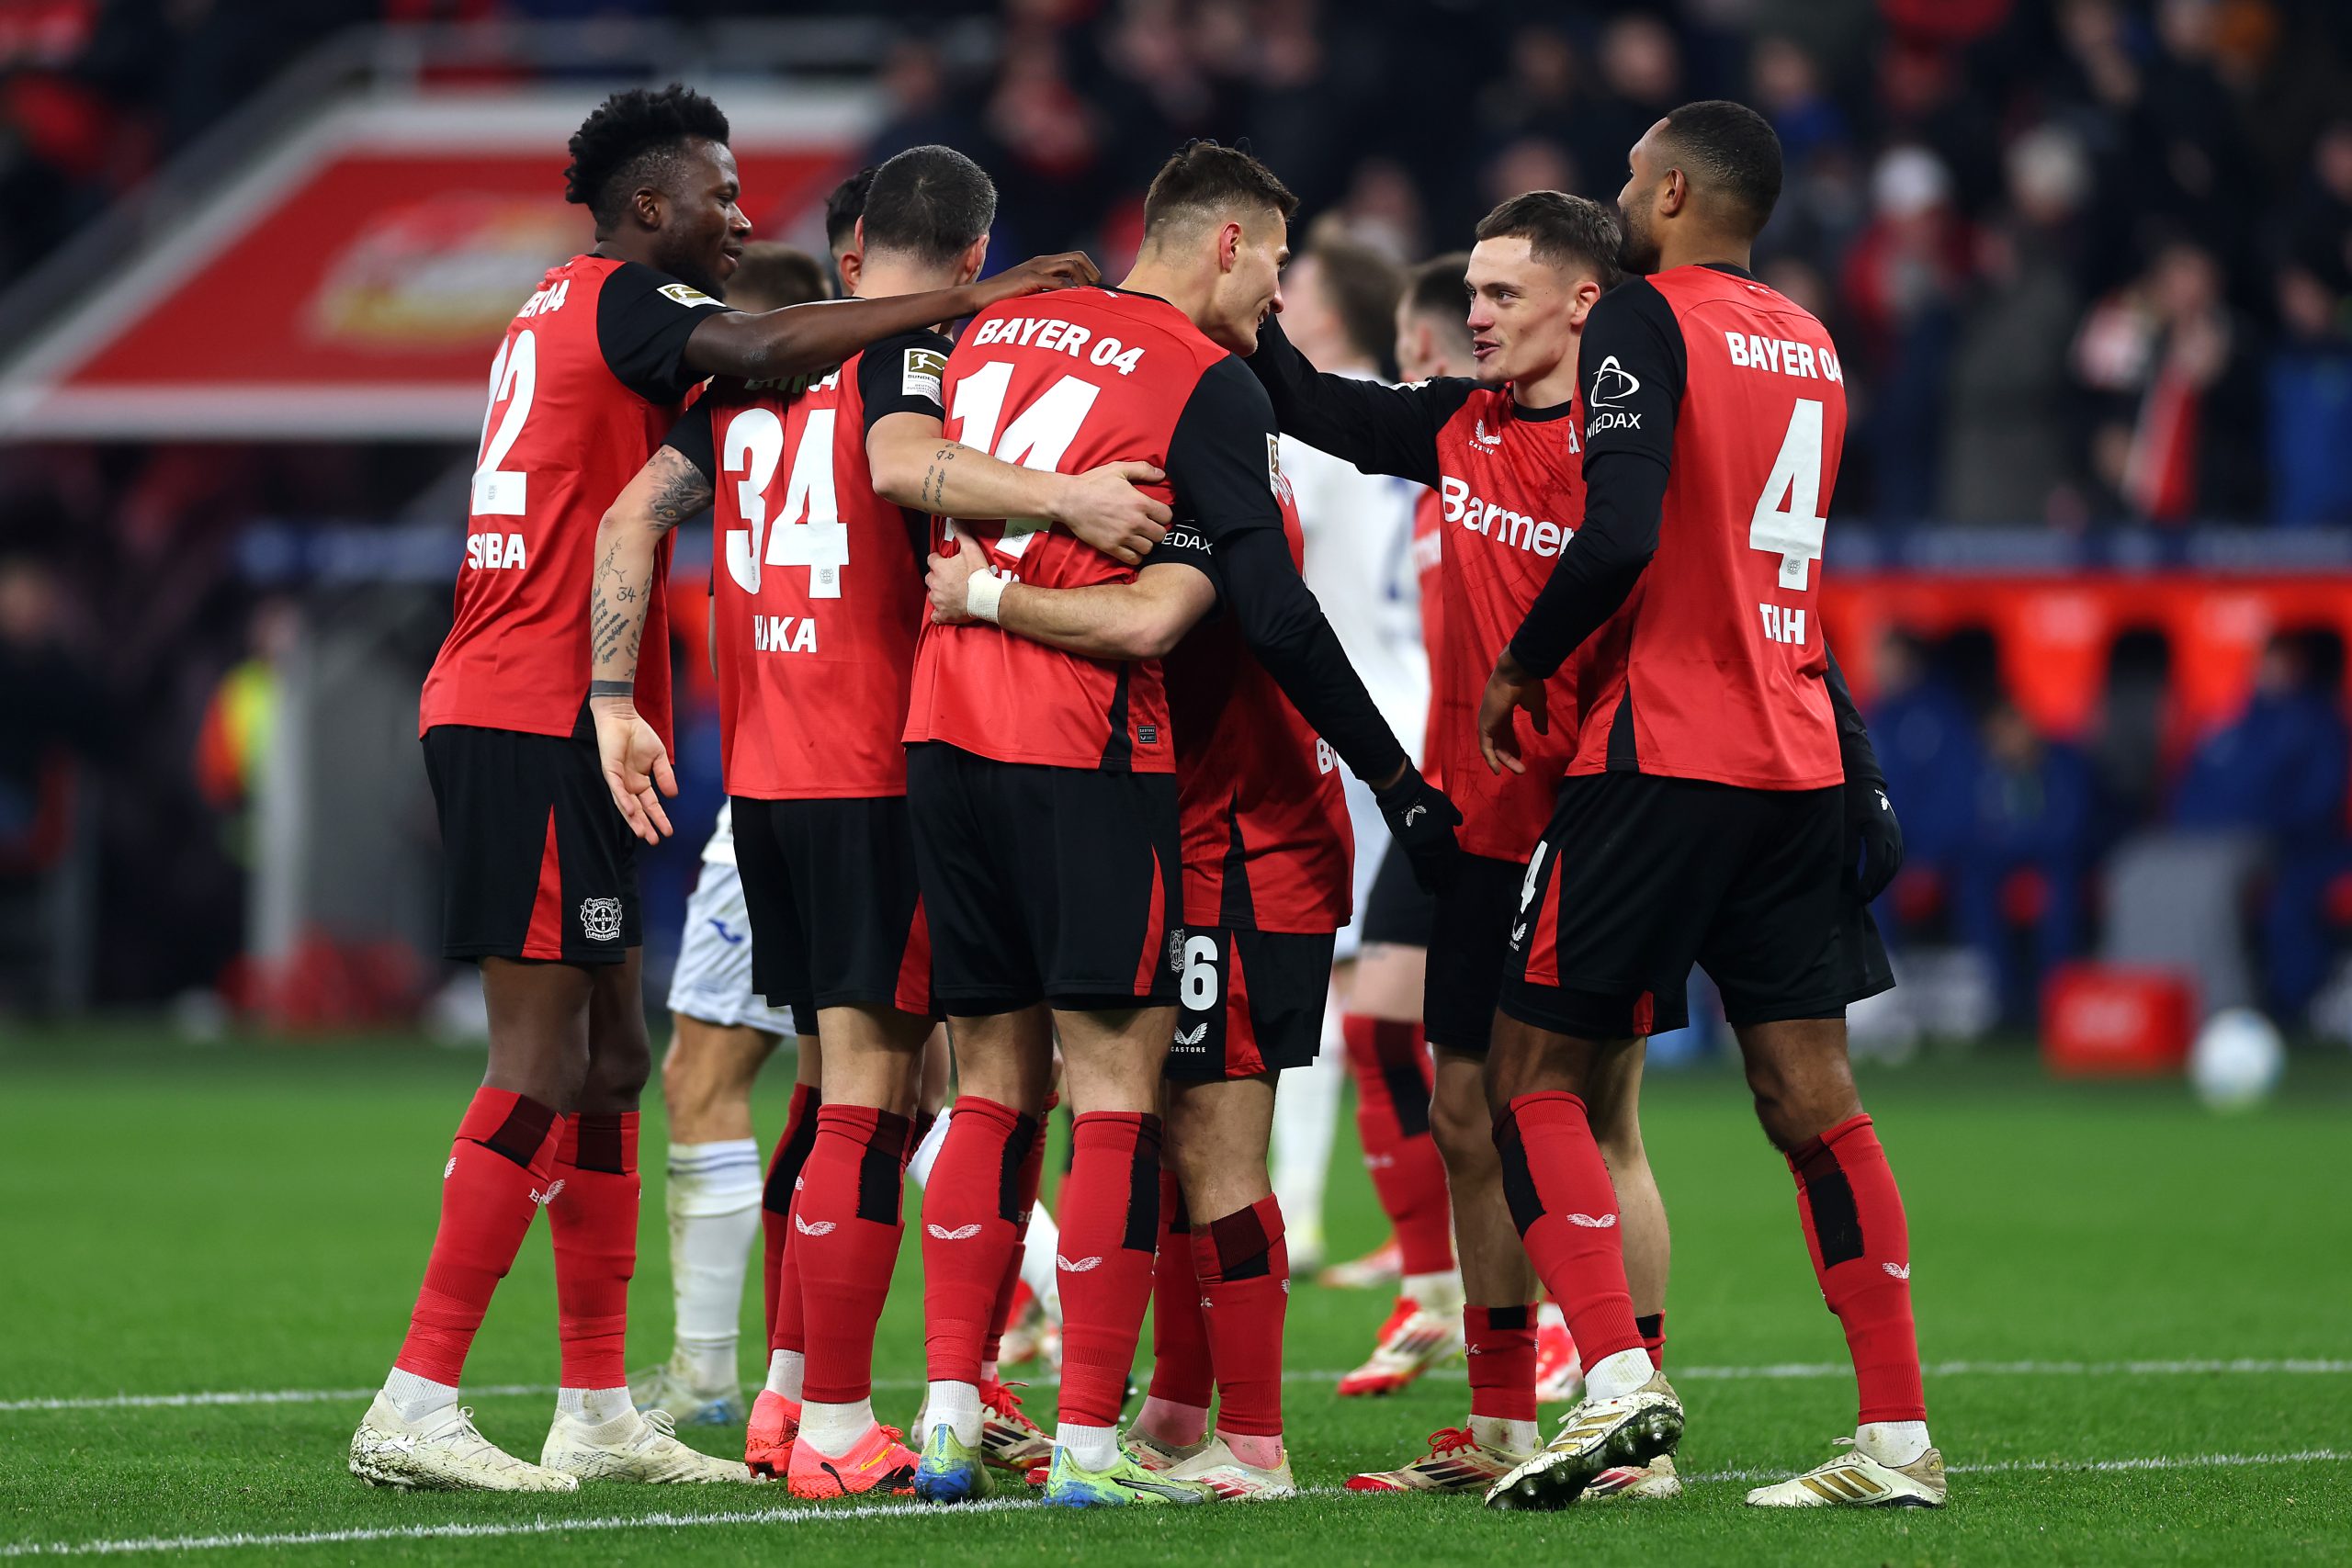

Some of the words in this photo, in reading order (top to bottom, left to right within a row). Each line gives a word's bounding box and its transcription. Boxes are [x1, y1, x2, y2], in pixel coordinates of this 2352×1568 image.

[972, 317, 1092, 357] BAYER
[1090, 337, 1146, 376] 04
[1724, 332, 1818, 379] BAYER
[1586, 412, 1643, 443] NIEDAX
[724, 408, 850, 599] 34
[1749, 398, 1826, 592] 4
[467, 533, 526, 570] SOBA
[1161, 532, 1214, 556] EDAX
[616, 586, 637, 604] 34
[753, 615, 817, 653] HAKA
[1759, 603, 1805, 645] TAH
